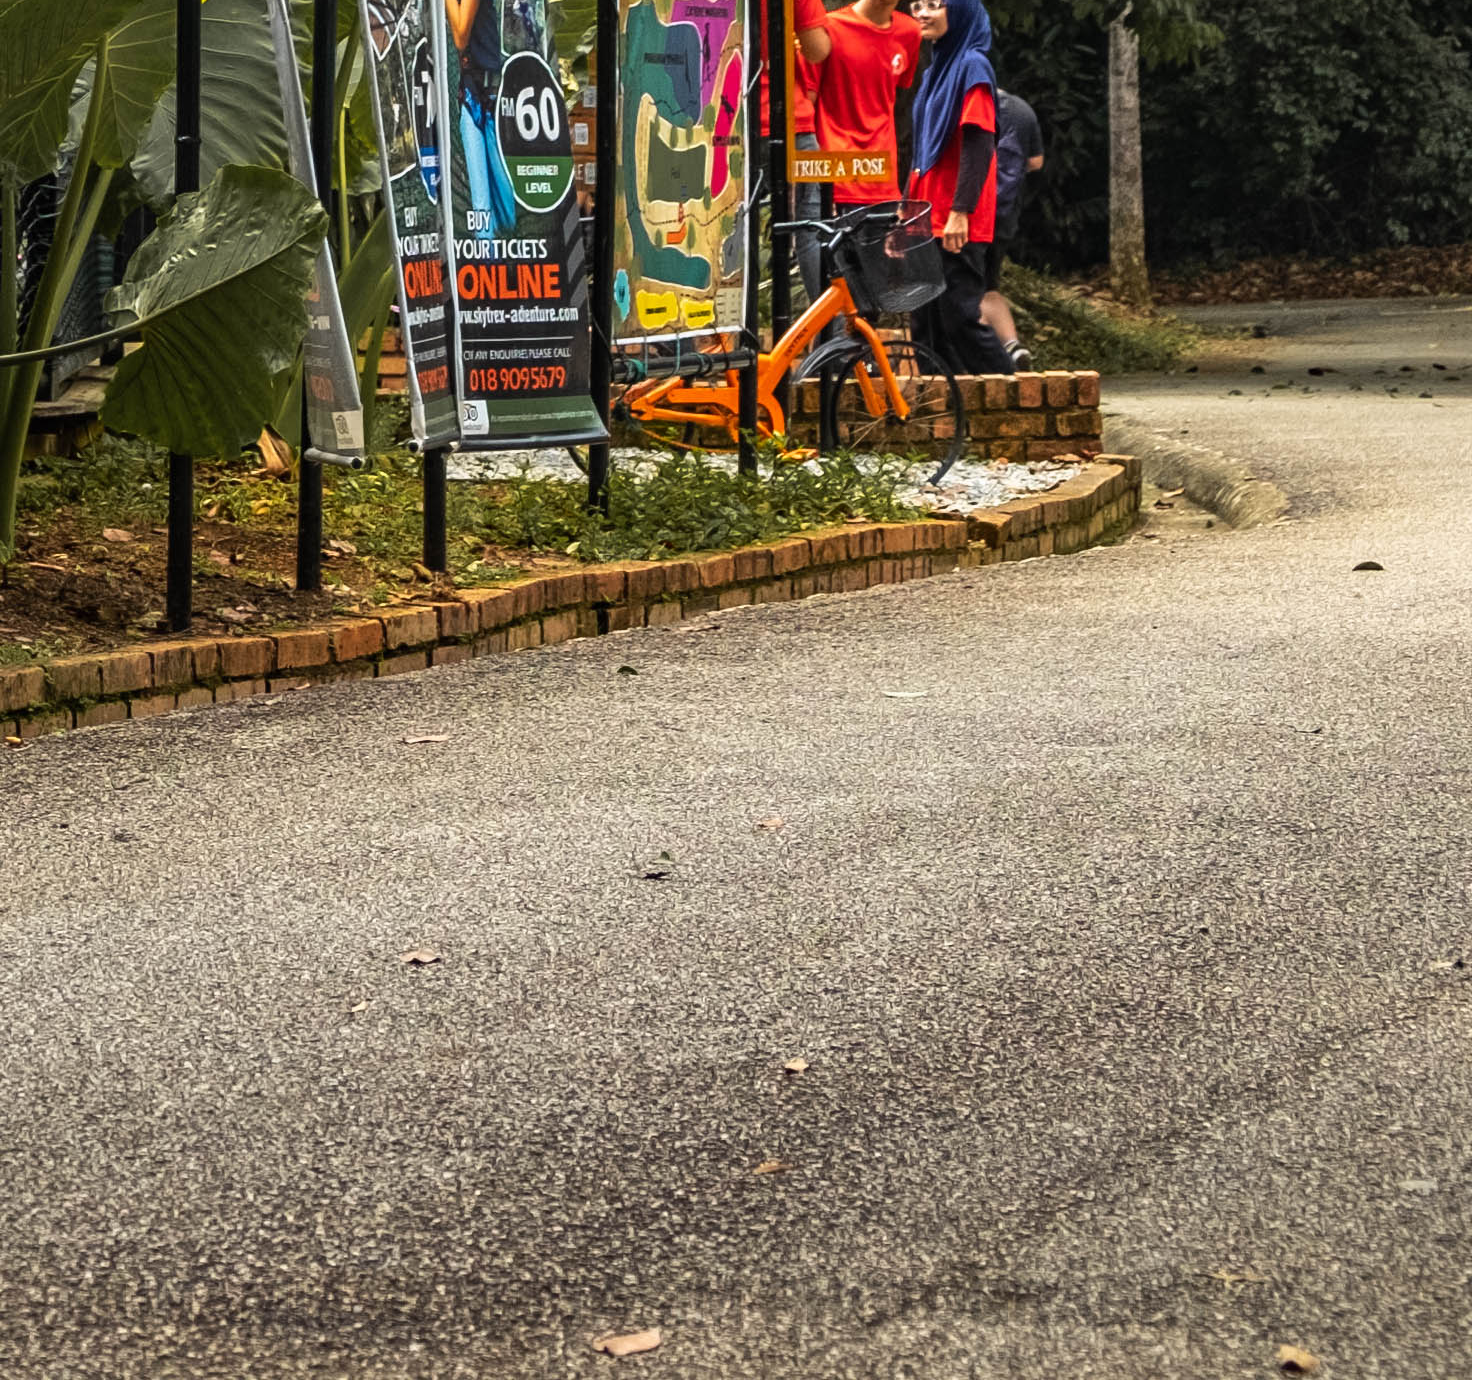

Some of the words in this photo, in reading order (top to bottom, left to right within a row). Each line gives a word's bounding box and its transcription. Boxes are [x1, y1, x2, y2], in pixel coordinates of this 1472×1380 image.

[515, 86, 561, 142] 60
[516, 164, 559, 177] BEGINNER
[793, 160, 832, 177] TRIKE
[835, 160, 846, 177] A
[852, 158, 886, 175] POSE
[525, 182, 553, 194] LEVEL
[466, 210, 491, 231] BUY
[455, 239, 491, 259] YOUR
[457, 264, 562, 300] ONLINE
[553, 348, 572, 358] CALL
[470, 368, 498, 391] 018
[499, 365, 567, 390] 9095679
